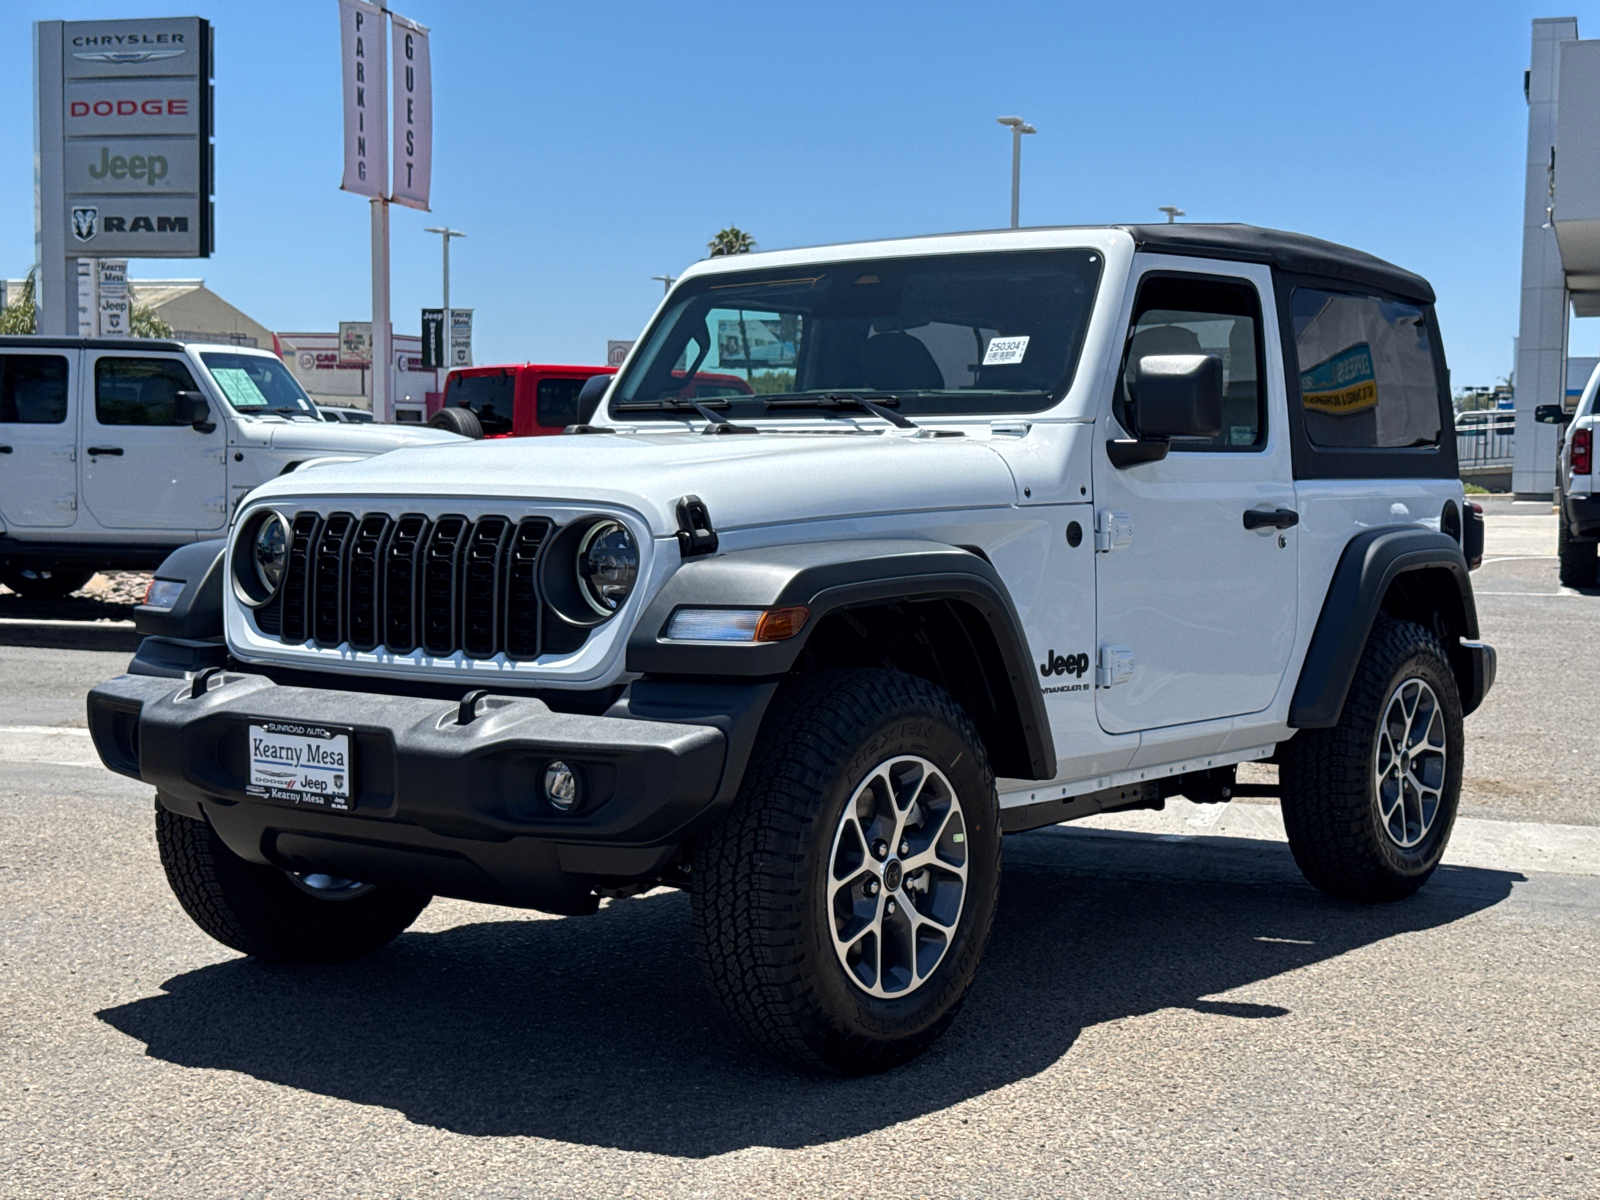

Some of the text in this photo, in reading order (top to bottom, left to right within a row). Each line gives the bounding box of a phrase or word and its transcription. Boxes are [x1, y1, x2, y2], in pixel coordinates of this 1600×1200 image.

[72, 33, 186, 46] CHRYSLER
[355, 11, 367, 182] PARKING
[71, 99, 188, 118] DODGE
[405, 33, 415, 189] GUEST
[88, 147, 169, 186] Jeep
[104, 216, 189, 232] RAM
[101, 262, 127, 274] Kearny
[104, 273, 124, 281] Mesa
[102, 299, 127, 312] Jeep
[423, 311, 443, 321] Jeep
[451, 340, 471, 348] Jeep
[989, 340, 1021, 351] 250304
[315, 353, 338, 363] CAR
[1040, 649, 1089, 679] Jeep
[1041, 684, 1082, 695] WRANGLER
[268, 723, 327, 736] SUNROAD AUTO
[252, 738, 345, 768] Kearny Mesa
[255, 777, 289, 786] DODGE
[300, 775, 328, 793] Jeep
[271, 788, 301, 804] Kearny
[302, 792, 325, 805] Mesa
